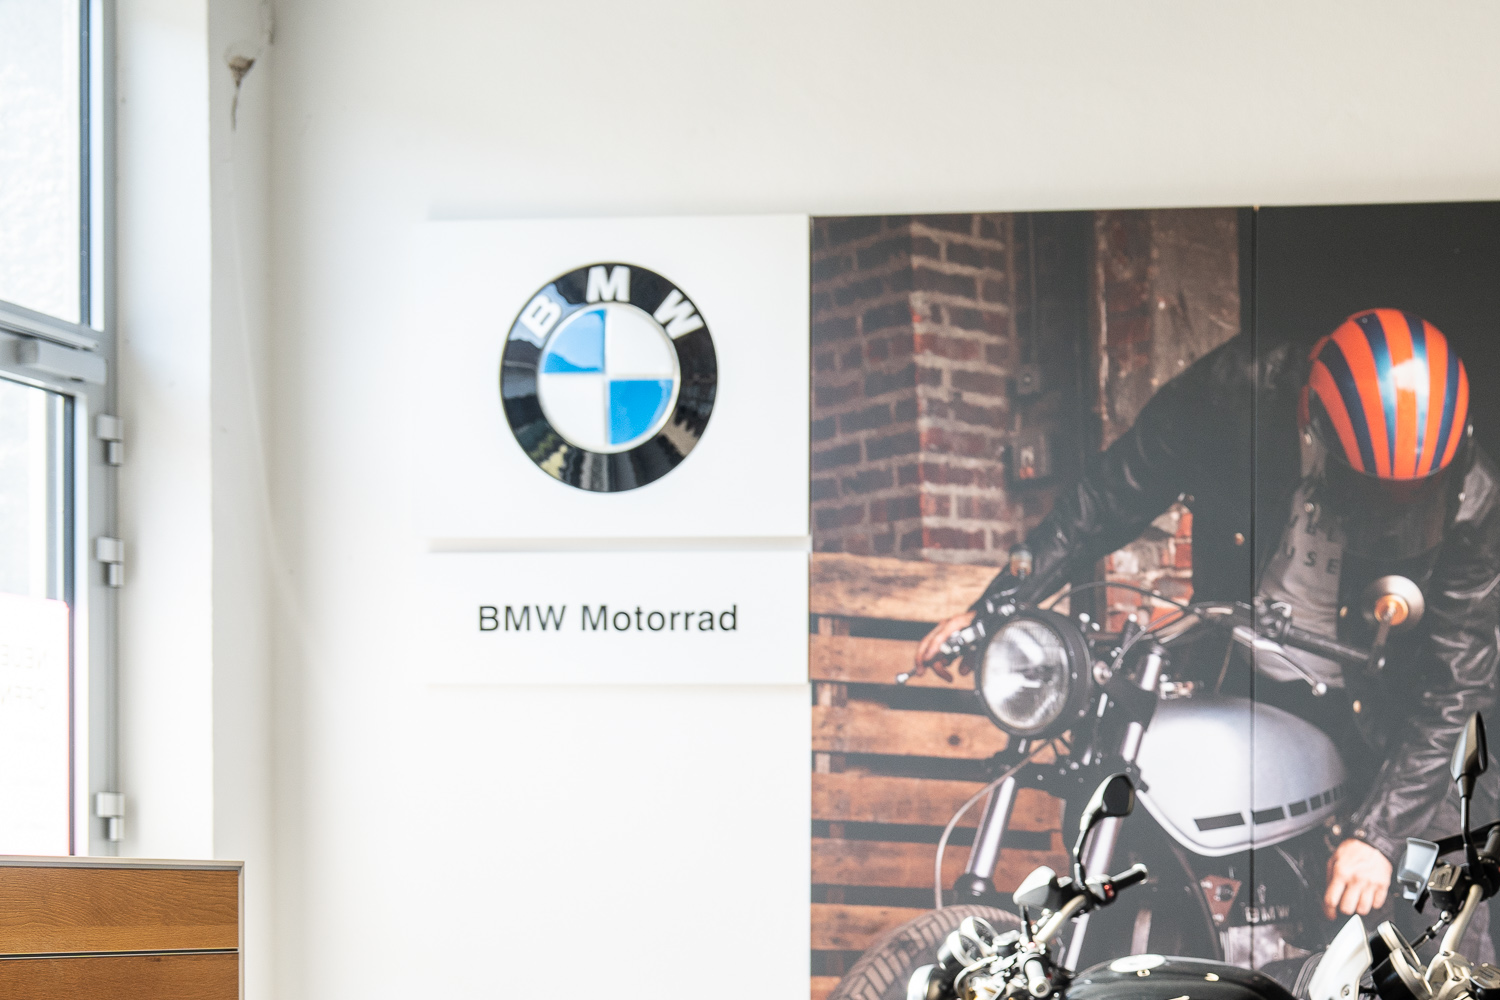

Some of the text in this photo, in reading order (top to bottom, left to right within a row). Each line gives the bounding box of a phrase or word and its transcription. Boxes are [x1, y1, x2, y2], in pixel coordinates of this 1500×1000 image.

[520, 265, 704, 340] BMW
[478, 604, 738, 632] BMW Motorrad
